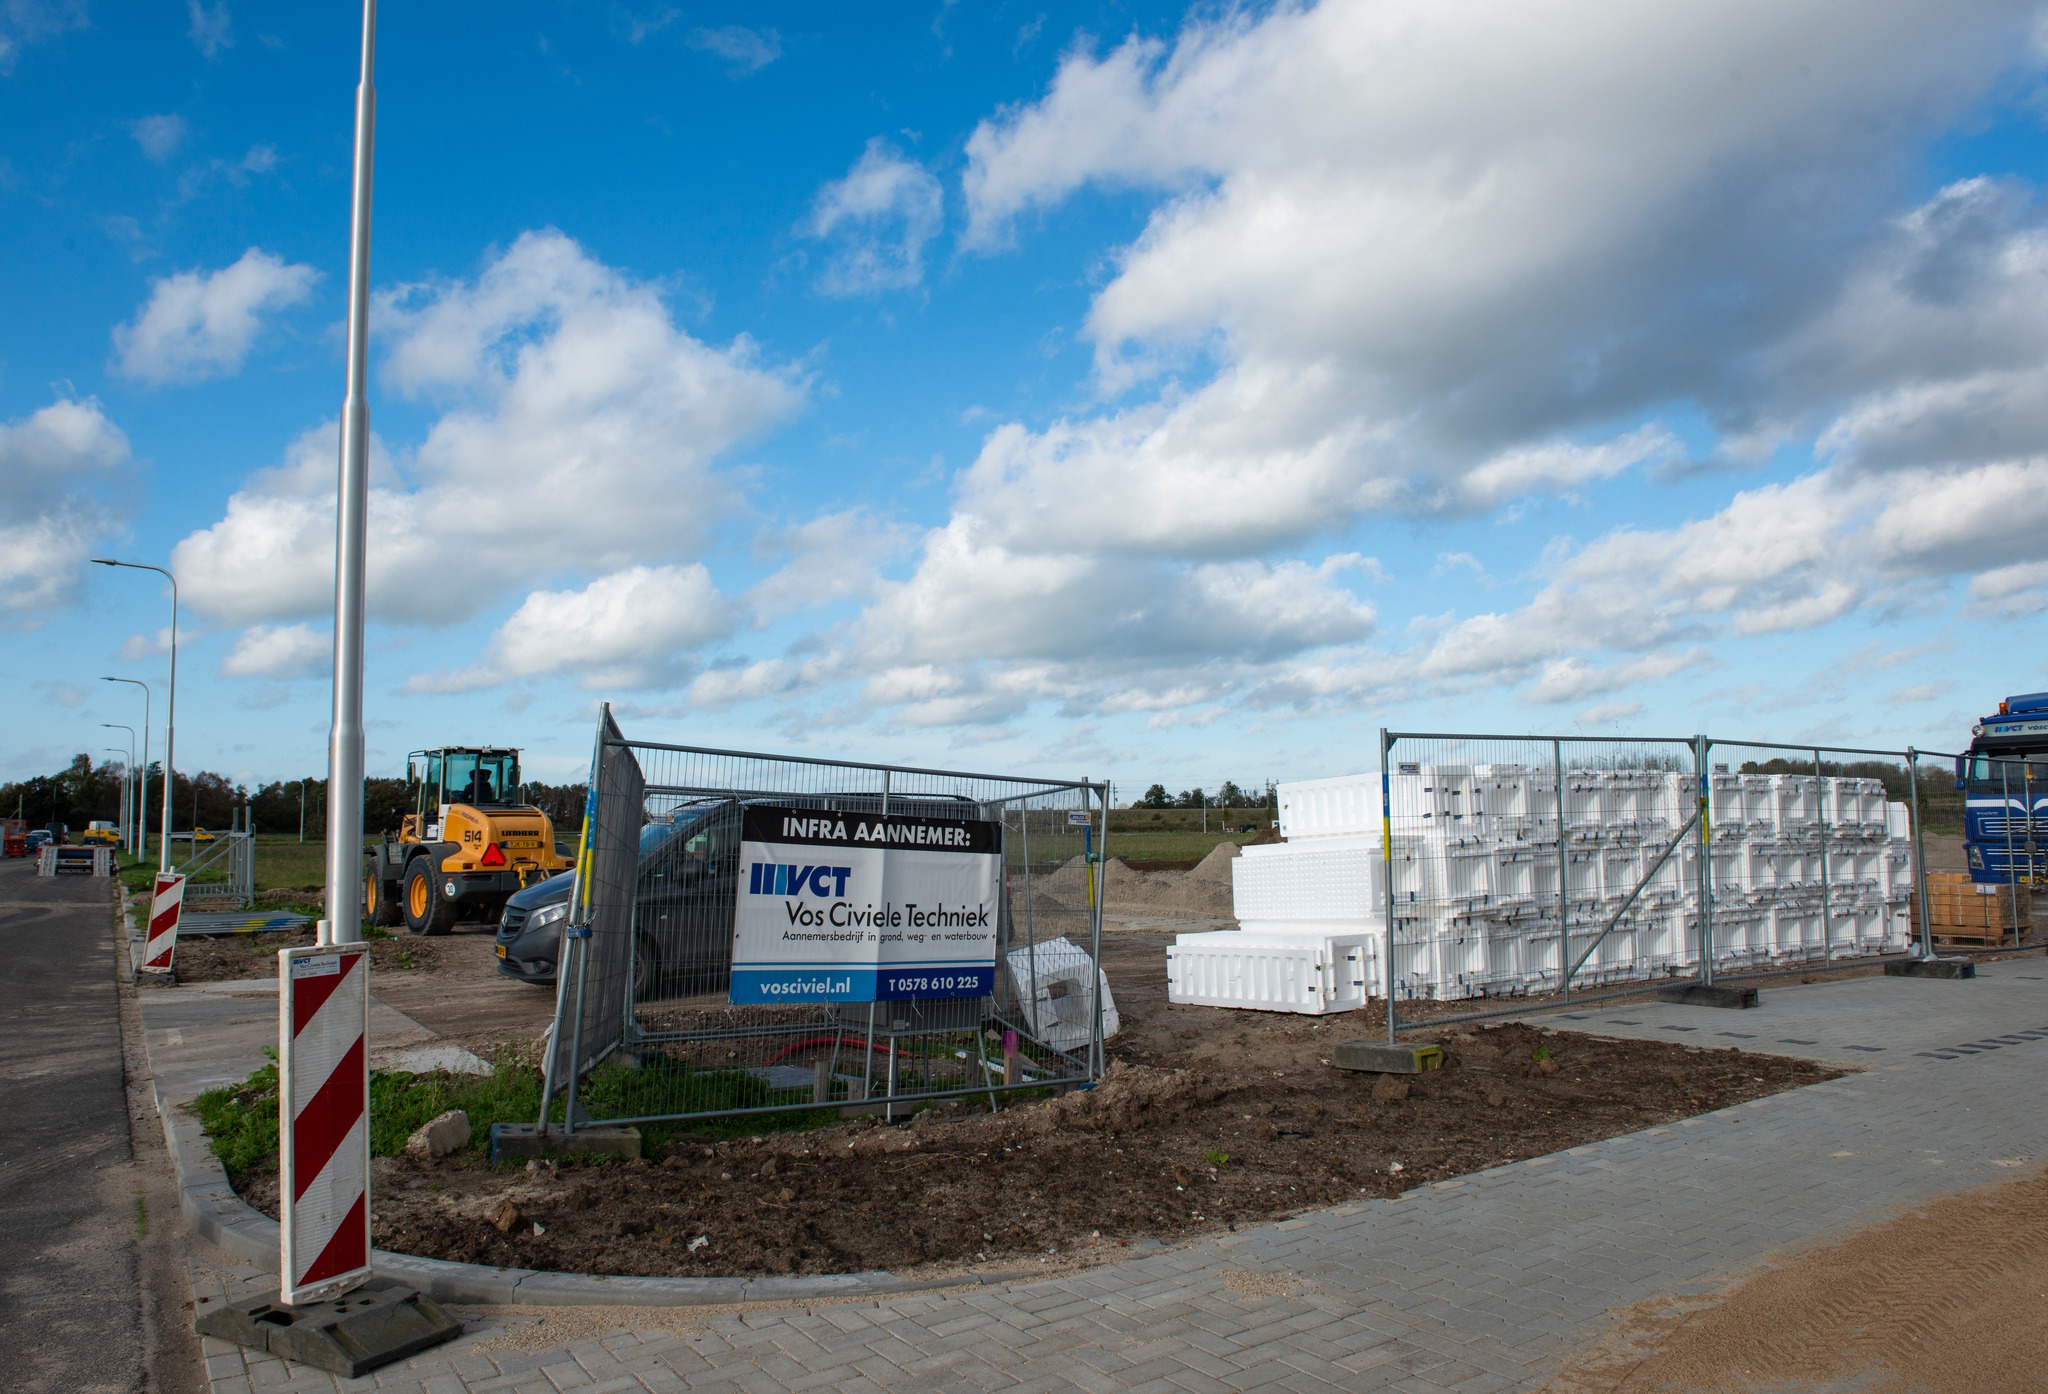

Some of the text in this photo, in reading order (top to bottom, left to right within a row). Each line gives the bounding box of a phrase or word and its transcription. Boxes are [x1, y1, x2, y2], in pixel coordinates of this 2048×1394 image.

[782, 817, 971, 846] INFRA AANNEMER:
[447, 884, 454, 894] 30
[785, 900, 989, 928] Vos Civiele Techniek
[782, 930, 988, 944] Aannemersbedrijf in grond, weg- en waterbouw
[760, 976, 978, 995] vosciviel.nl T 0578 610 225
